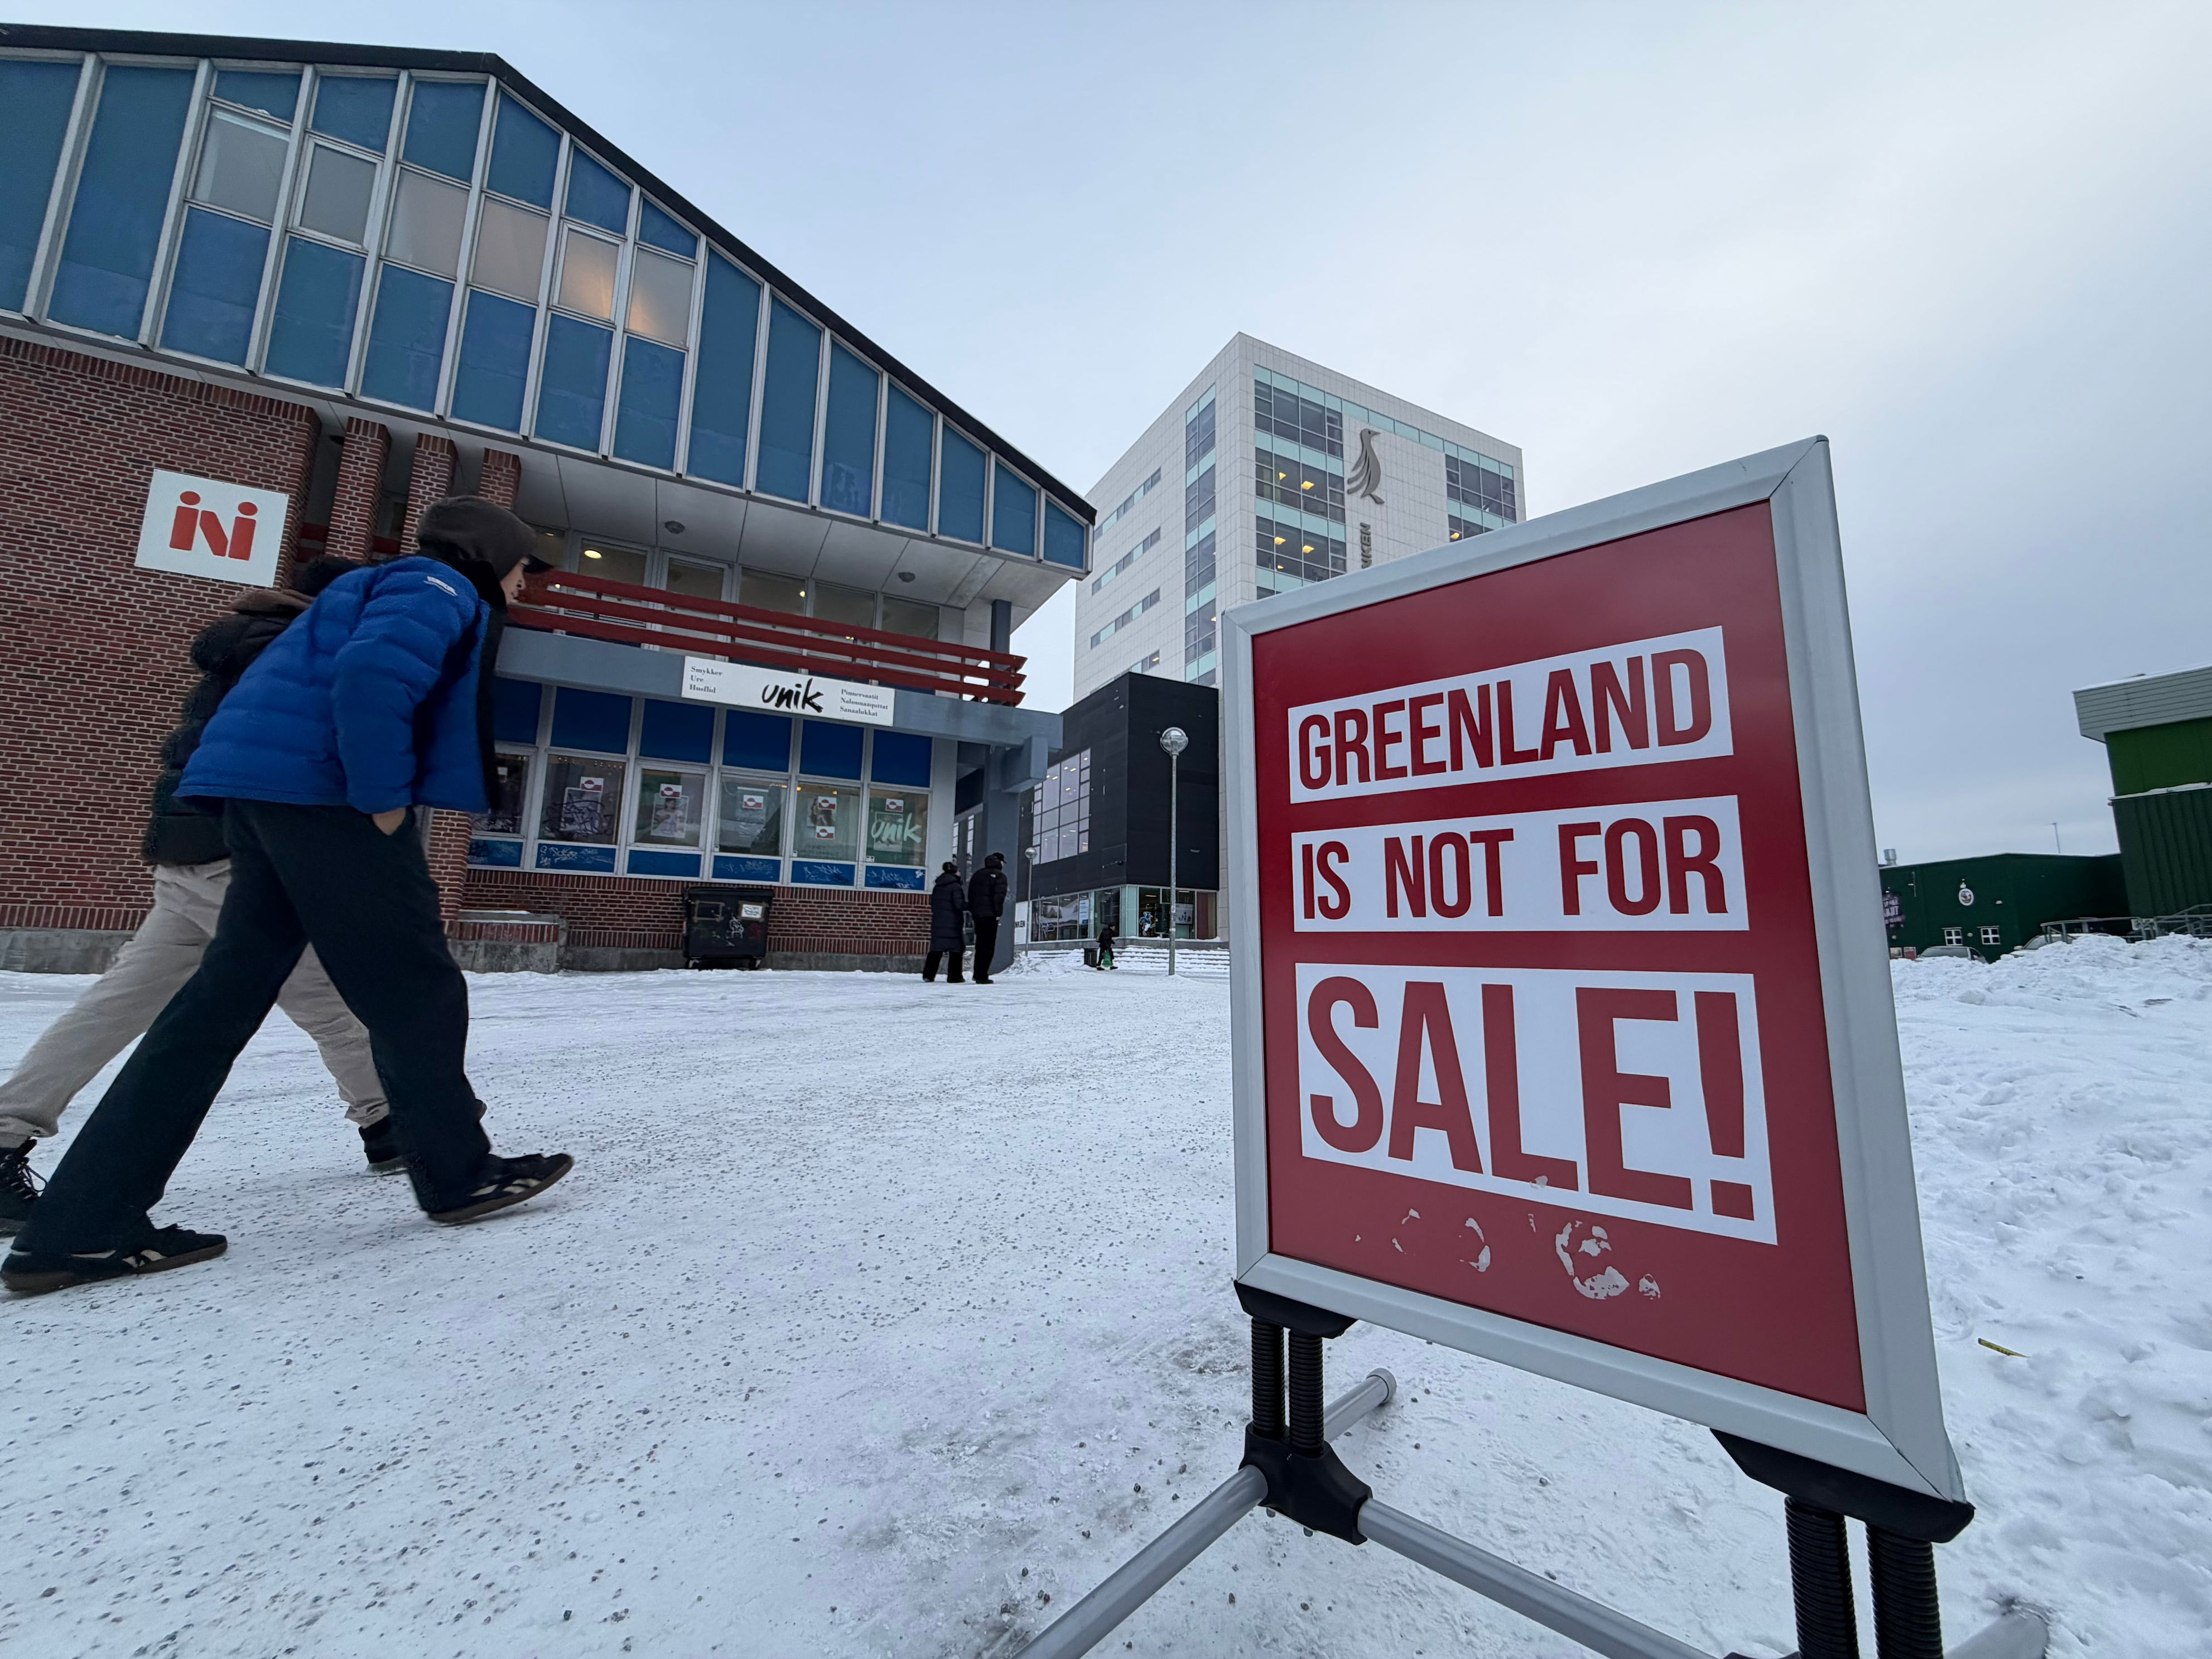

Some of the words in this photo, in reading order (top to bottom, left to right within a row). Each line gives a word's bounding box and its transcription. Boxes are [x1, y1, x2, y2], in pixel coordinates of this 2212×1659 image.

[691, 666, 723, 676] Smykker
[690, 684, 716, 693] Husflid
[762, 678, 824, 713] unik
[841, 688, 879, 700] Pinnersaatit
[840, 706, 878, 717] Sanaalukkat
[1298, 648, 1712, 790] GREENLAND
[1301, 841, 1351, 920] IS
[1384, 828, 1515, 919] NOT
[1558, 815, 1729, 917] FOR
[1307, 975, 1756, 1222] SALE!
